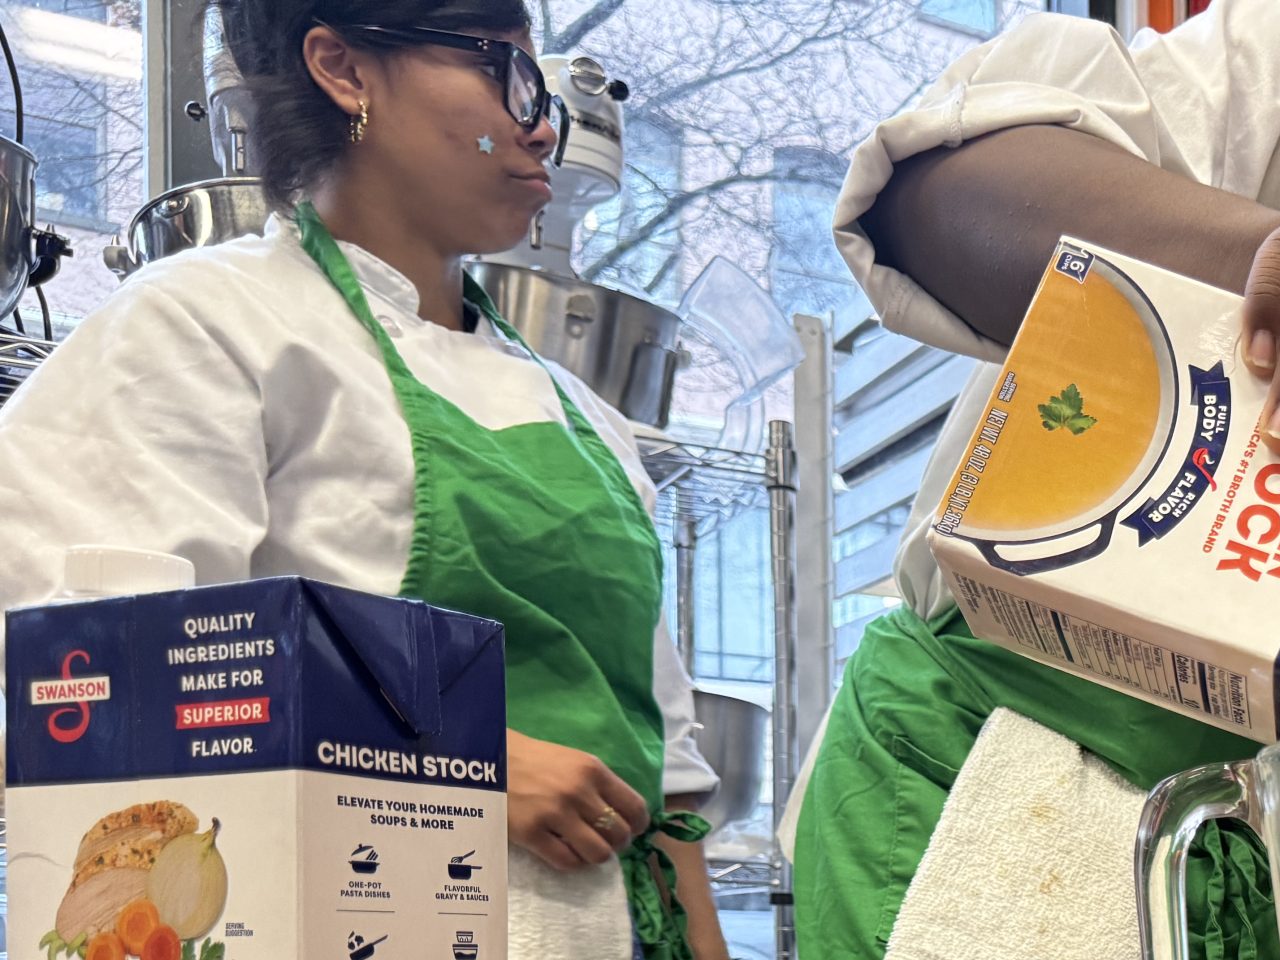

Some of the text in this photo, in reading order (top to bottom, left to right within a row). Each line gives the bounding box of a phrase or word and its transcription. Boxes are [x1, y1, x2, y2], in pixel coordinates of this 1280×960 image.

[988, 408, 1008, 428] NET
[1201, 394, 1217, 442] BODY
[1216, 405, 1228, 434] FULL
[978, 426, 1000, 444] WT.
[973, 444, 992, 460] 48
[966, 456, 986, 473] OZ.
[1148, 472, 1196, 523] FLAVOR
[1172, 492, 1196, 518] RICH
[1203, 460, 1250, 553] #1 BROTH BRAND
[184, 612, 255, 638] QUALITY
[168, 640, 275, 665] INGREDIENTS
[1176, 654, 1191, 684] Calories
[36, 681, 106, 700] SWANSON
[182, 670, 263, 692] MAKE FOR
[1229, 673, 1243, 710] Nutrition
[184, 702, 262, 724] SUPERIOR
[318, 742, 496, 782] CHICKEN STOCK
[337, 796, 484, 818] ELEVATE YOUR HOMEMADE
[370, 814, 454, 830] SOUPS & MORE
[340, 890, 390, 898] PASTA DISHES
[348, 881, 382, 890] ONE-POT
[444, 884, 481, 893] FLAVORFUL
